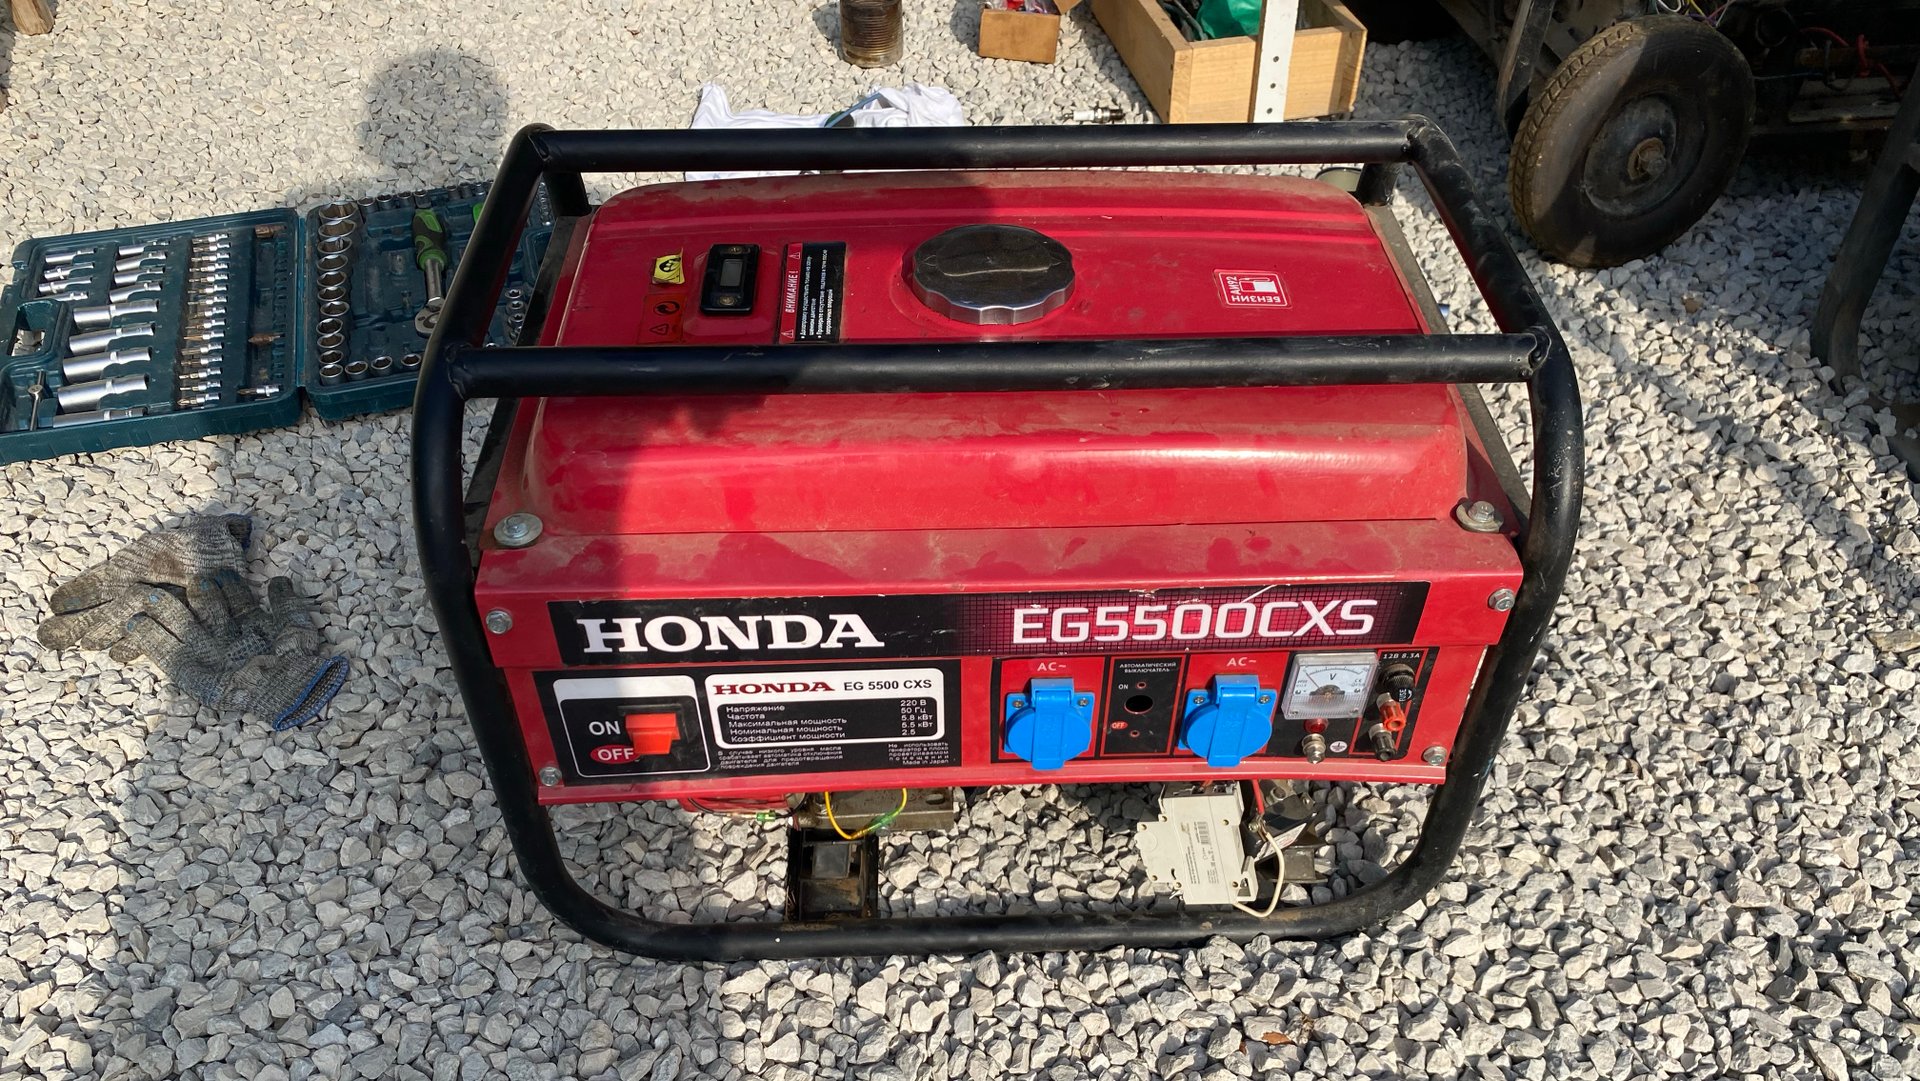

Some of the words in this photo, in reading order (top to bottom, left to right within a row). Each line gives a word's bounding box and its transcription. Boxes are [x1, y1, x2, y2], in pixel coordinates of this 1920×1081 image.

[1231, 295, 1281, 303] БЕНЗИН
[1013, 600, 1378, 643] EG5500CXS
[576, 614, 885, 653] HONDA
[713, 681, 835, 695] HONDA
[844, 681, 864, 691] EG
[868, 680, 899, 690] 5500
[903, 679, 932, 689] CXS
[726, 705, 785, 713] Напряжение
[900, 699, 917, 707] 220
[588, 720, 621, 735] ON
[729, 720, 798, 728] Максимальная
[730, 727, 794, 735] Номинальная
[731, 734, 796, 742] Коэффициент
[799, 732, 846, 740] мощности
[597, 748, 634, 760] OFF
